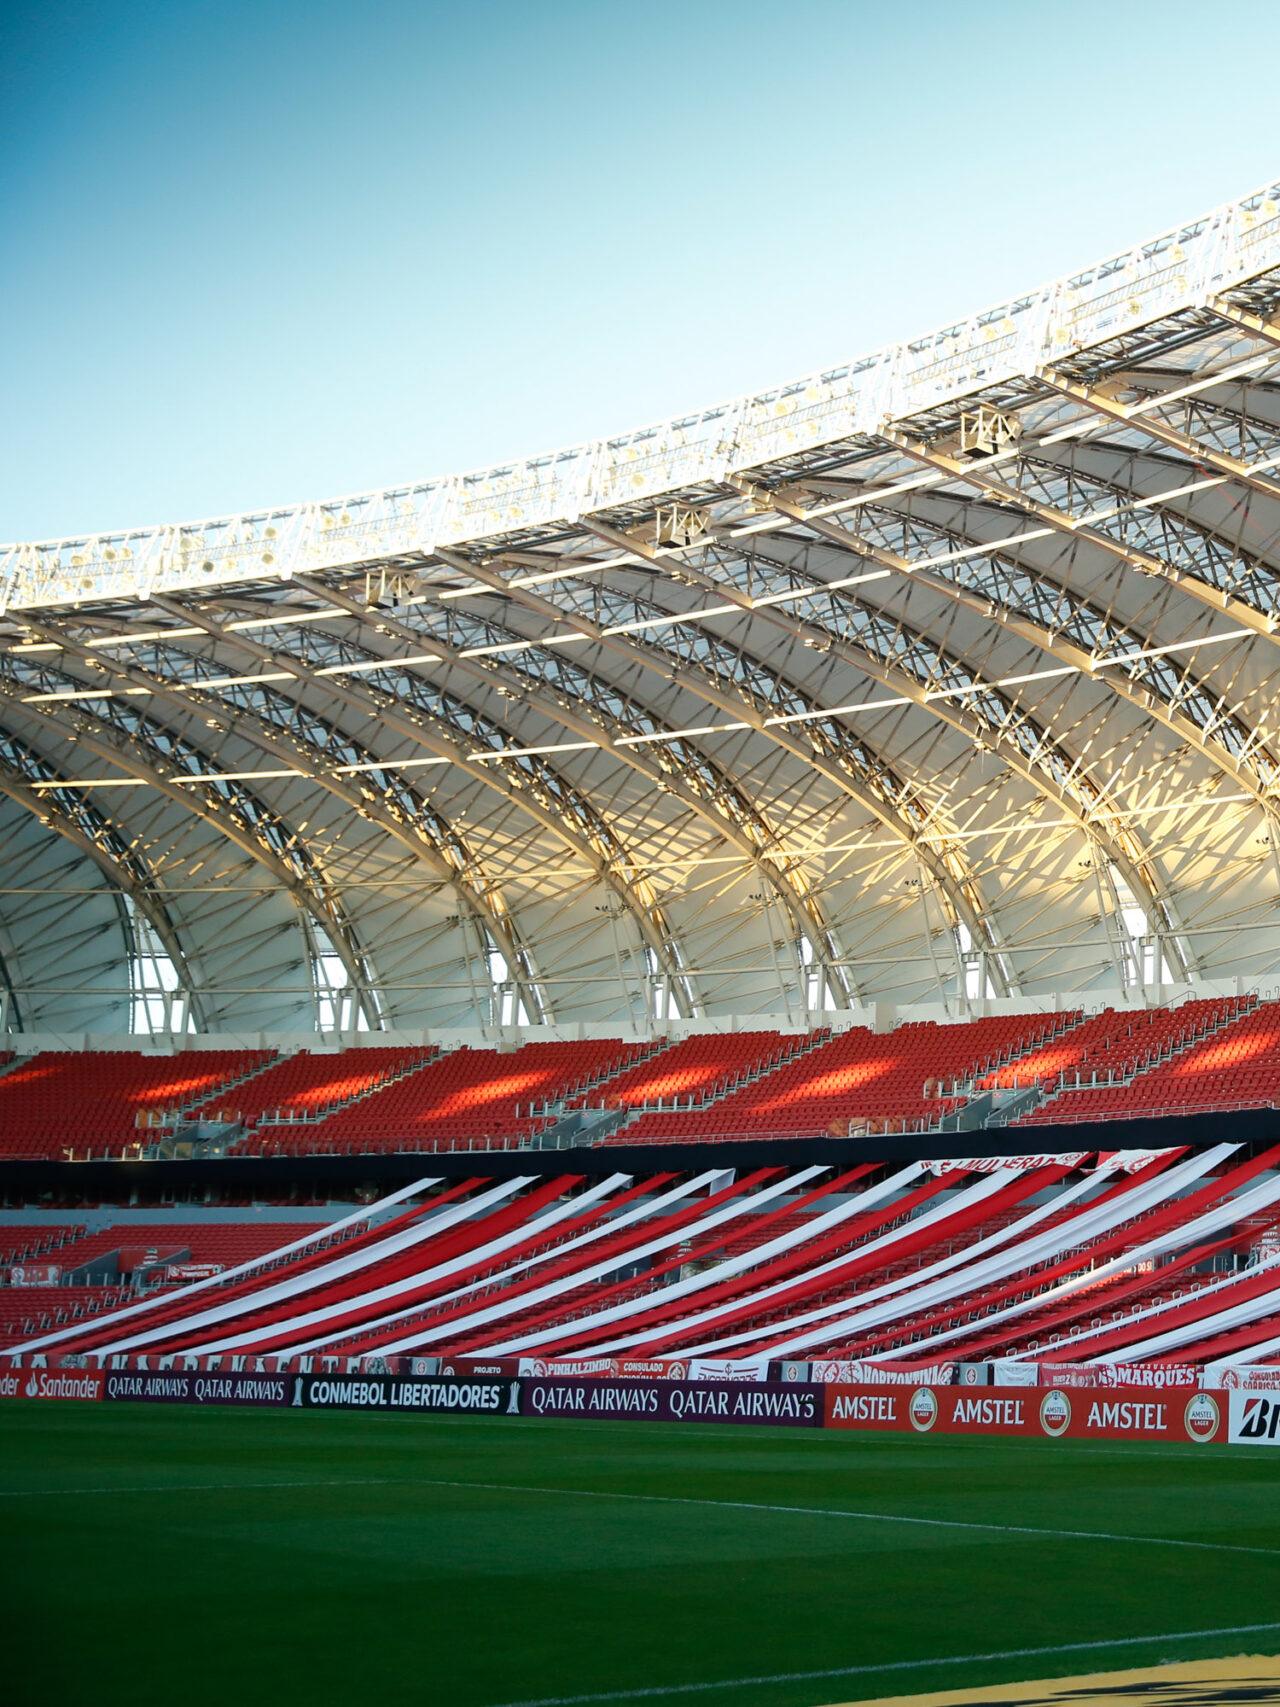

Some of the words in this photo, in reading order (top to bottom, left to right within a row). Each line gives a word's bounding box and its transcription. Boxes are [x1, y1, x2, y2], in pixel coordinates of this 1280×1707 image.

[473, 1366, 502, 1374] PROJETO
[547, 1358, 611, 1375] PINHALZINHO
[623, 1363, 664, 1372] CONSULADO
[1116, 1366, 1196, 1388] MARQUES
[39, 1373, 100, 1398] Santander
[108, 1377, 142, 1398] QATAR
[144, 1378, 188, 1397] AIRWAYS
[195, 1379, 231, 1401] QATAR
[234, 1380, 284, 1400] AIRWAYS
[310, 1381, 386, 1405] CONMEBOL
[391, 1383, 500, 1408] LIBERTADORES
[532, 1387, 585, 1413] QATAR
[589, 1388, 658, 1412] AIRWAYS
[670, 1390, 729, 1418] QATAR
[733, 1392, 815, 1418] AIRWAYS
[832, 1396, 896, 1420] AMSTEL
[952, 1399, 1025, 1425] AMSTEL
[1087, 1402, 1167, 1430] AMSTEL
[1191, 1410, 1212, 1418] AMSTEL
